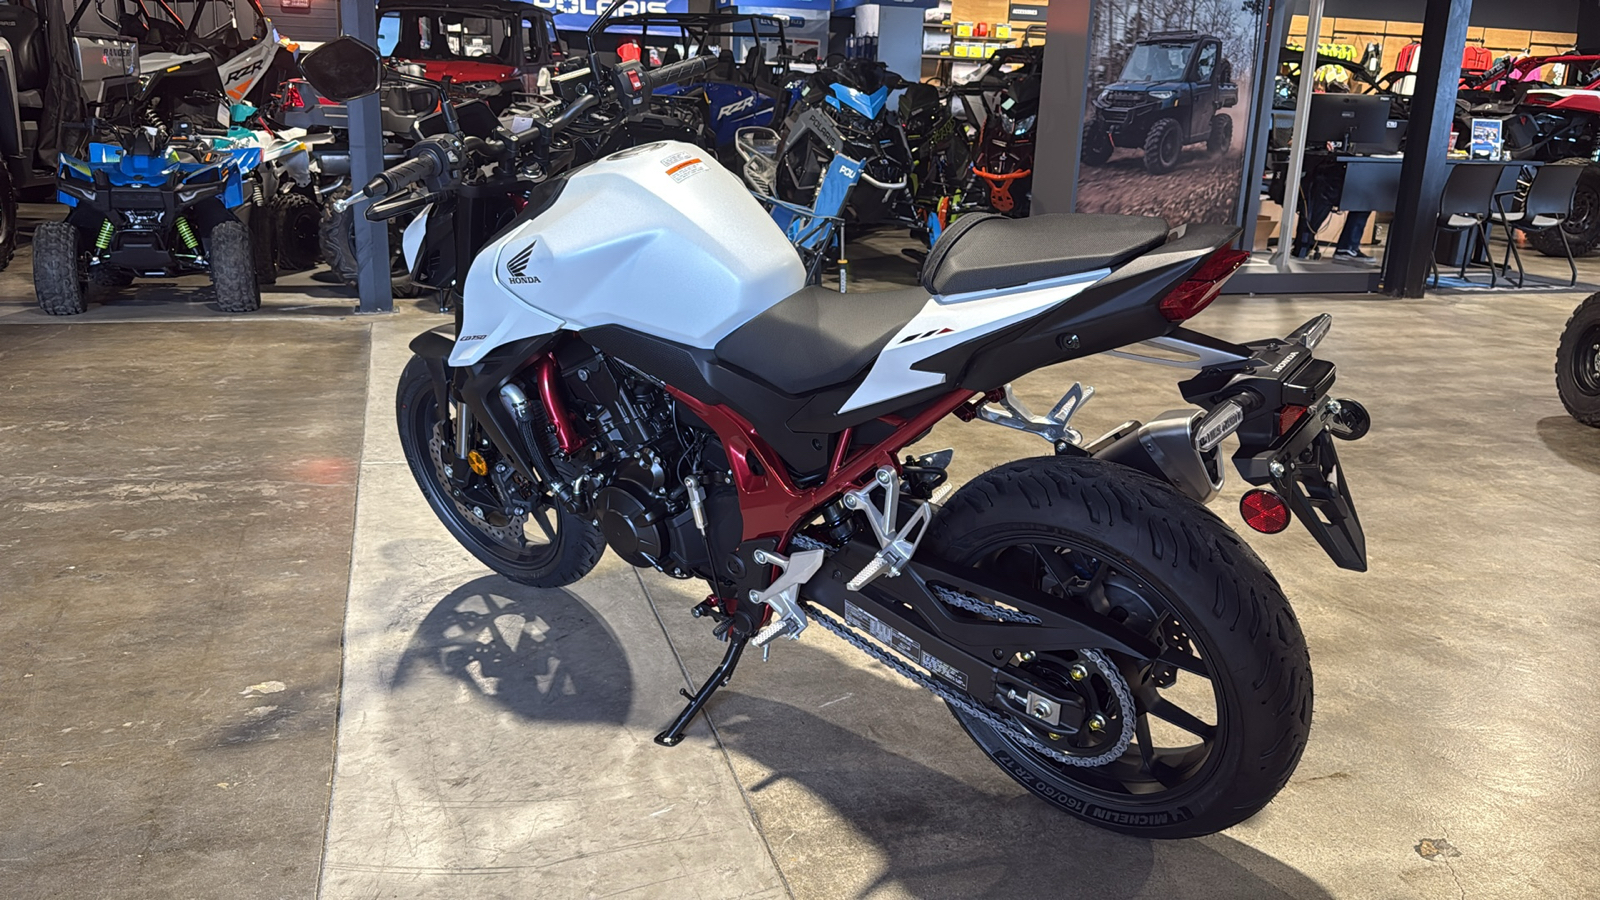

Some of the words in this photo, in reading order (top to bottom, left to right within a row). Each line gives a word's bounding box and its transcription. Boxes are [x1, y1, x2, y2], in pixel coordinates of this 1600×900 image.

[103, 48, 131, 57] RANGER
[224, 59, 263, 86] RZR
[717, 95, 754, 121] RZR
[809, 115, 836, 146] POLARIS
[508, 276, 541, 284] HONDA
[1272, 351, 1299, 373] HONDA
[999, 756, 1014, 768] 17
[1014, 767, 1035, 782] ZR
[1035, 781, 1083, 812] 160/60
[1092, 807, 1168, 824] MICHELIN
